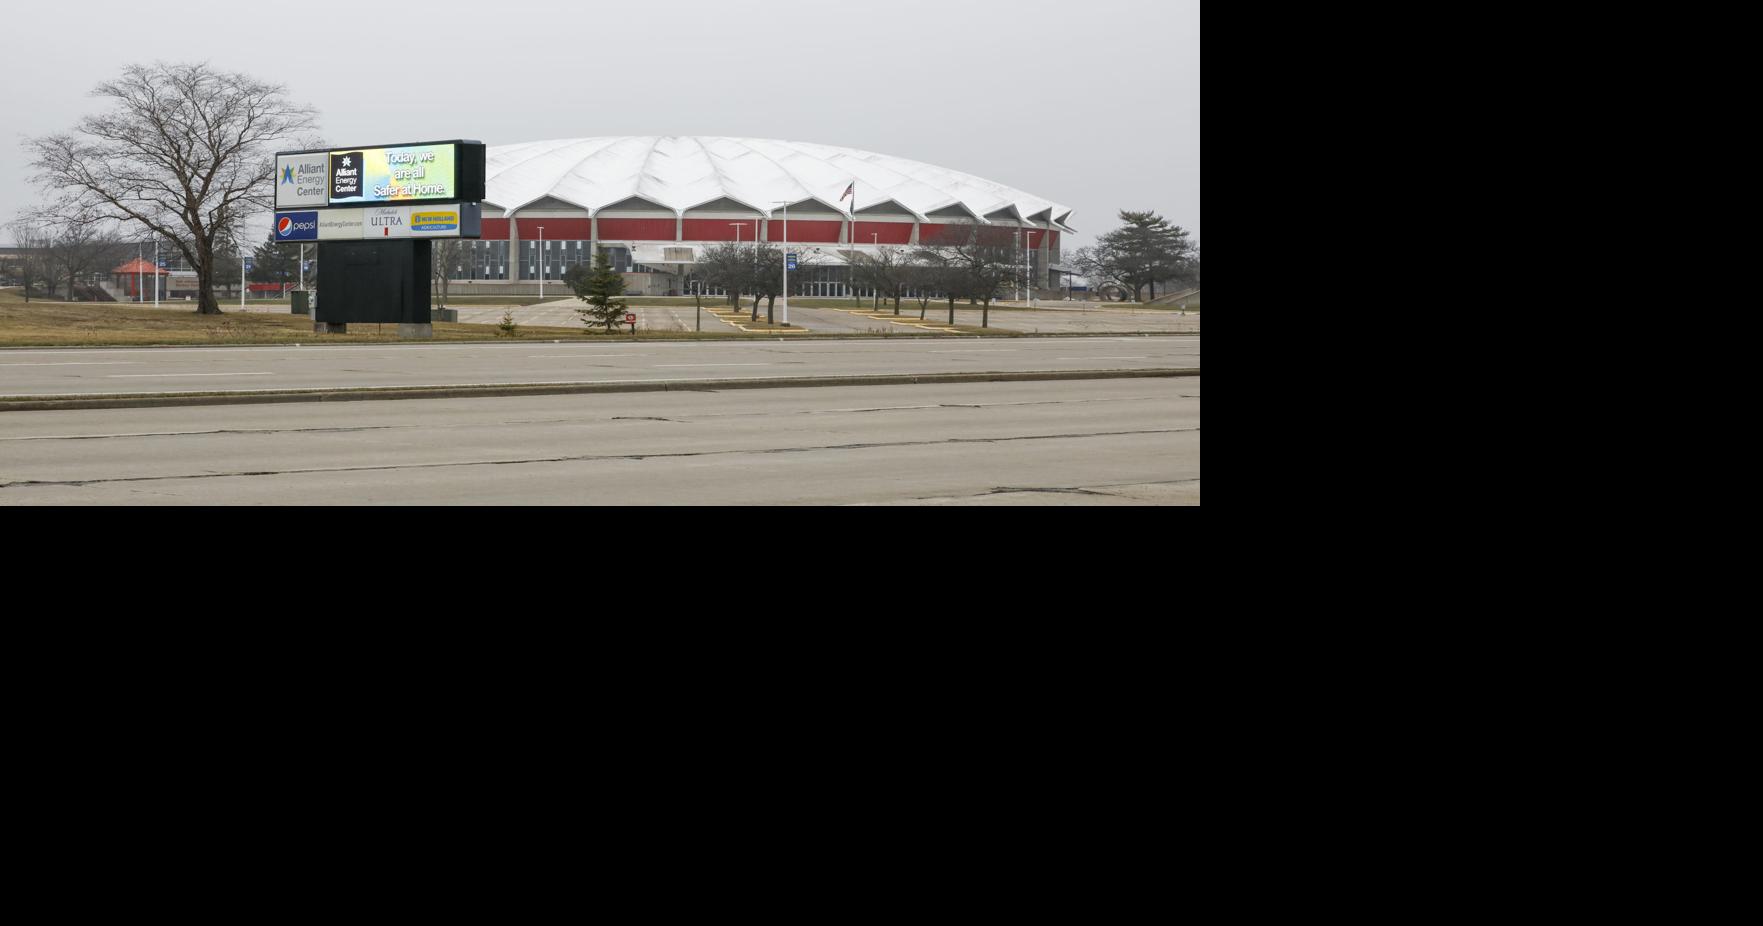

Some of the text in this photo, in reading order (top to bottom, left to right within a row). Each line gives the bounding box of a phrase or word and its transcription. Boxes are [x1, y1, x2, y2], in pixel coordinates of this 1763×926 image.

[386, 152, 433, 164] Today, we
[298, 163, 324, 174] Alliant
[336, 168, 357, 176] Alliant
[394, 166, 424, 179] are all
[297, 175, 324, 185] Energy
[336, 176, 357, 184] Energy
[297, 187, 324, 196] Center
[336, 184, 356, 192] Center
[374, 185, 401, 196] Safer
[402, 184, 412, 194] at
[294, 220, 315, 231] pepsi
[371, 216, 402, 226] ULTRA
